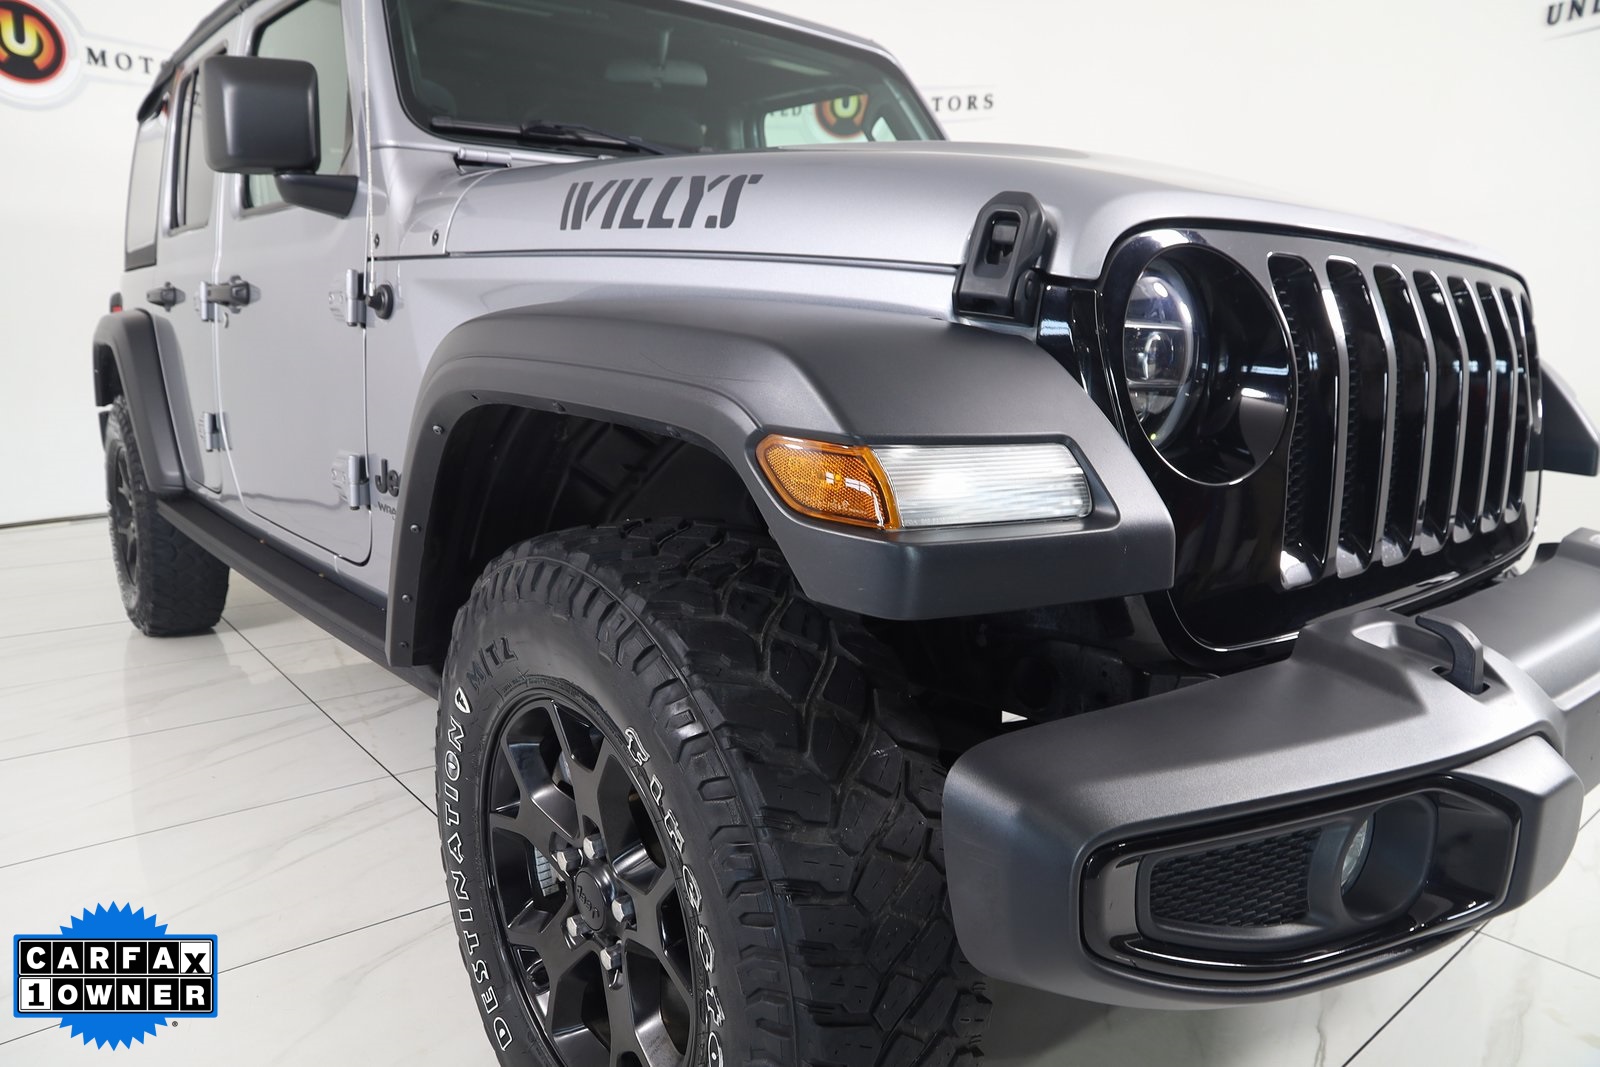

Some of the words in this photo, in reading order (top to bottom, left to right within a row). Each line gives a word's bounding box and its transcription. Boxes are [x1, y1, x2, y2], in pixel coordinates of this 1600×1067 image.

[932, 94, 994, 112] TORS
[560, 174, 764, 231] WILLYS
[444, 716, 513, 1051] DESTINATION
